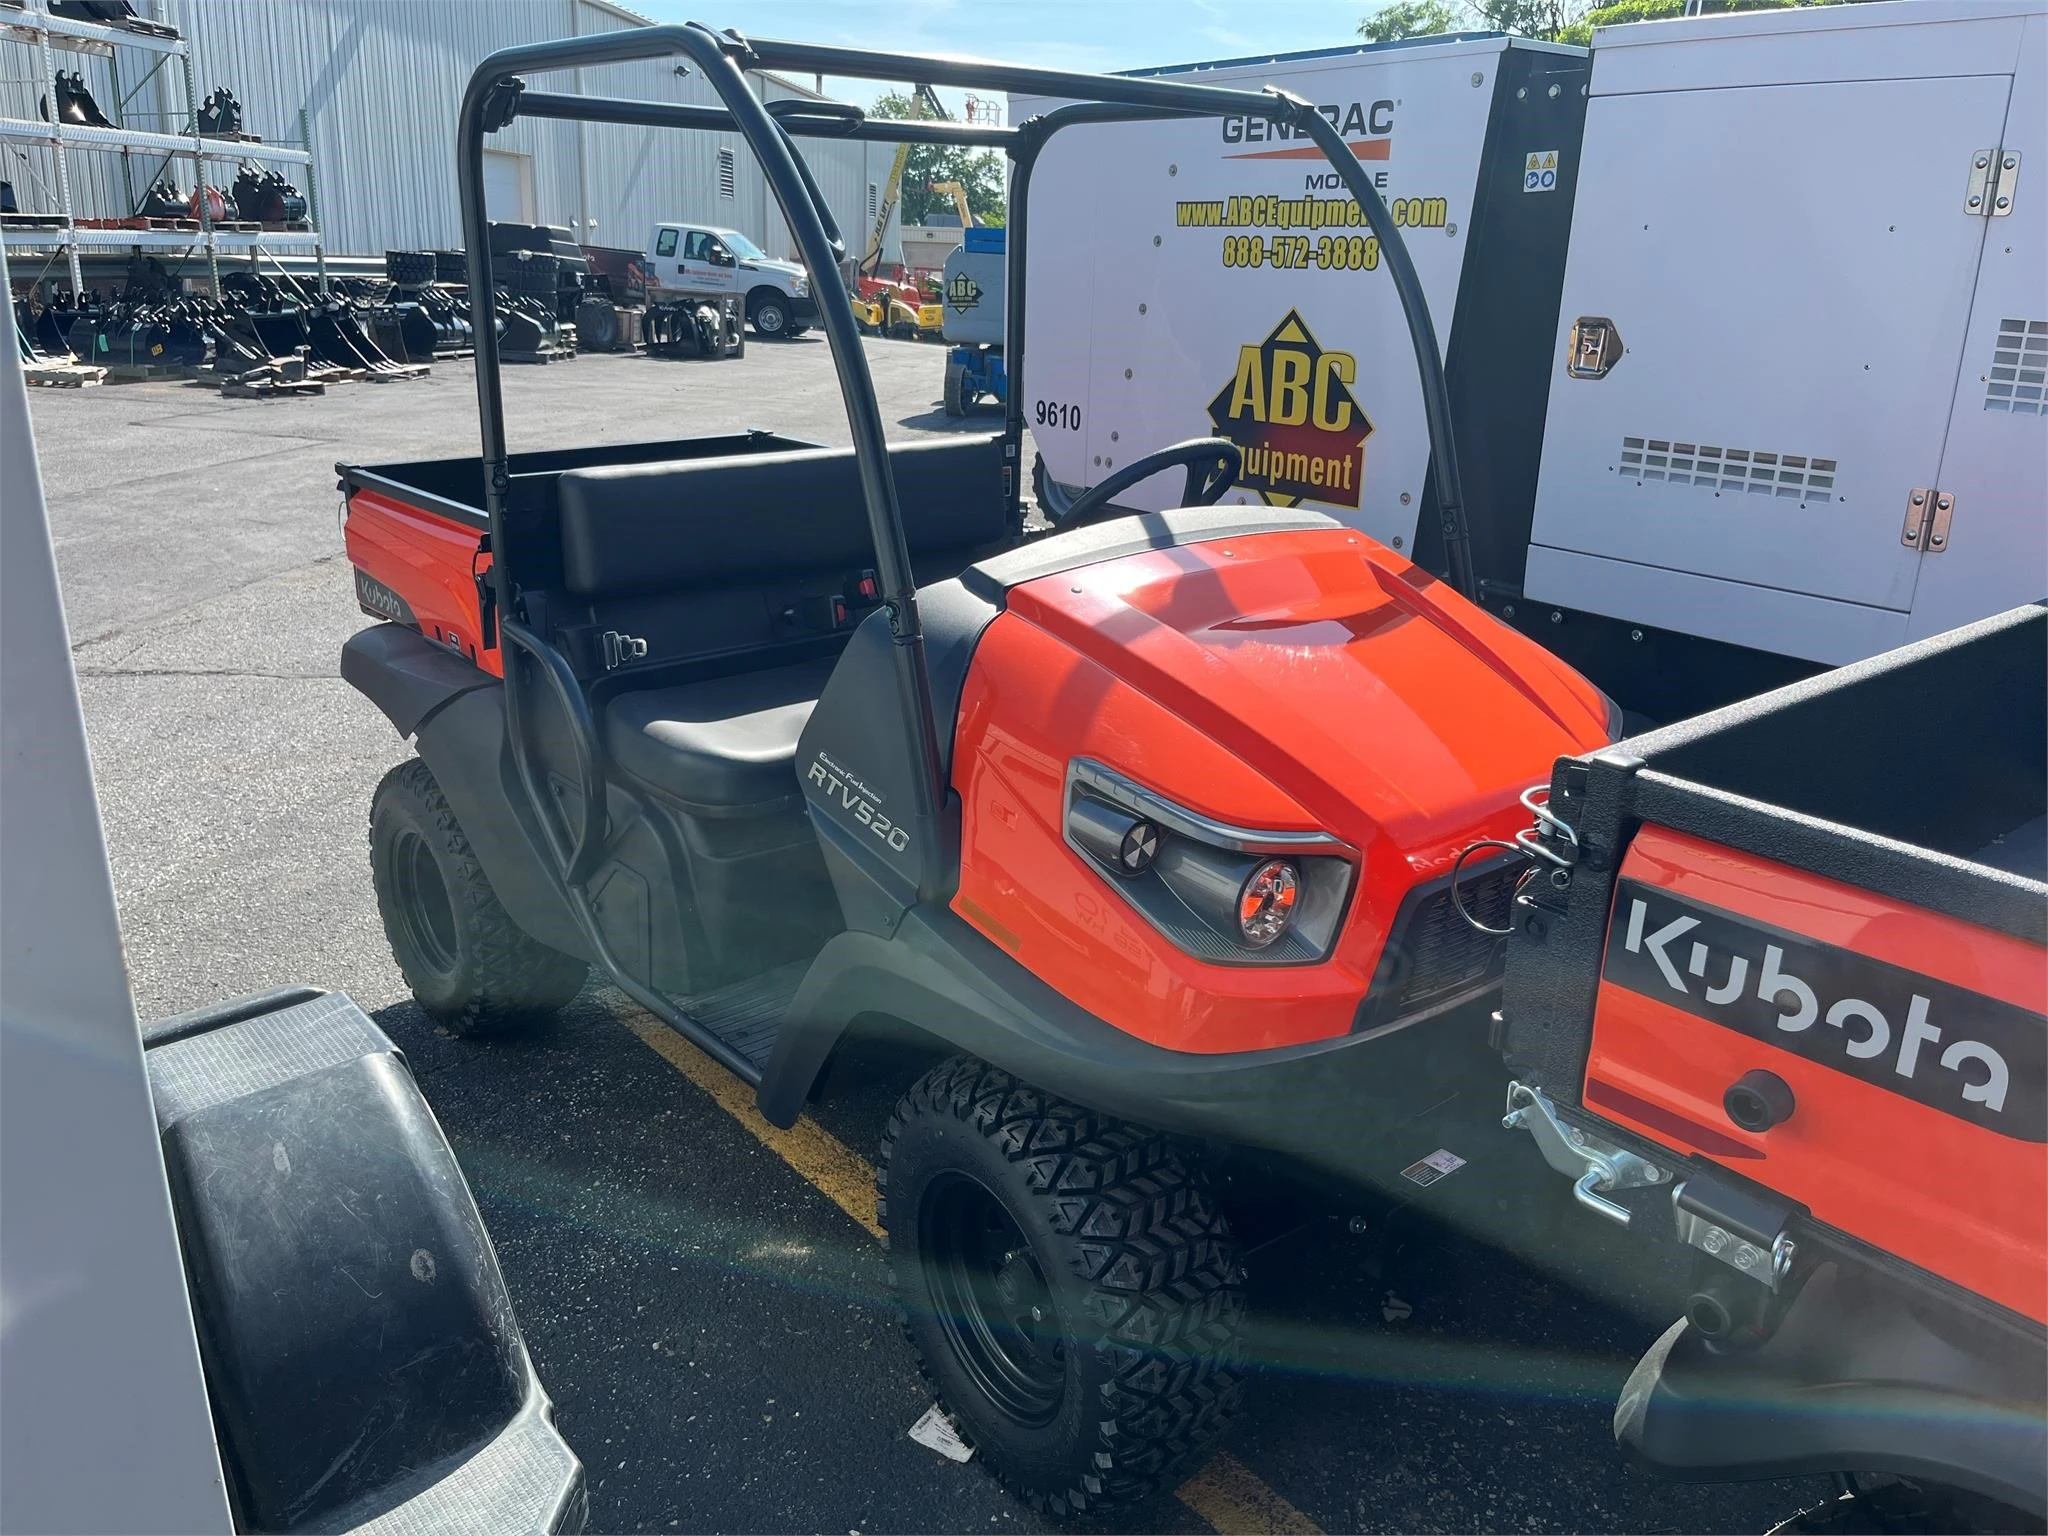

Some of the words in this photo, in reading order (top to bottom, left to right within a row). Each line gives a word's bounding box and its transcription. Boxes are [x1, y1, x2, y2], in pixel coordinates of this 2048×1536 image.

[1305, 172, 1389, 190] MOE
[1222, 236, 1381, 271] 888-572-3888
[949, 280, 977, 297] ABC
[1228, 346, 1356, 432] ABC
[1036, 400, 1081, 431] 9610
[1217, 435, 1353, 490] quipment
[360, 578, 401, 617] Kubota
[807, 761, 910, 852] RTV520
[1624, 898, 2010, 1112] Kubota
